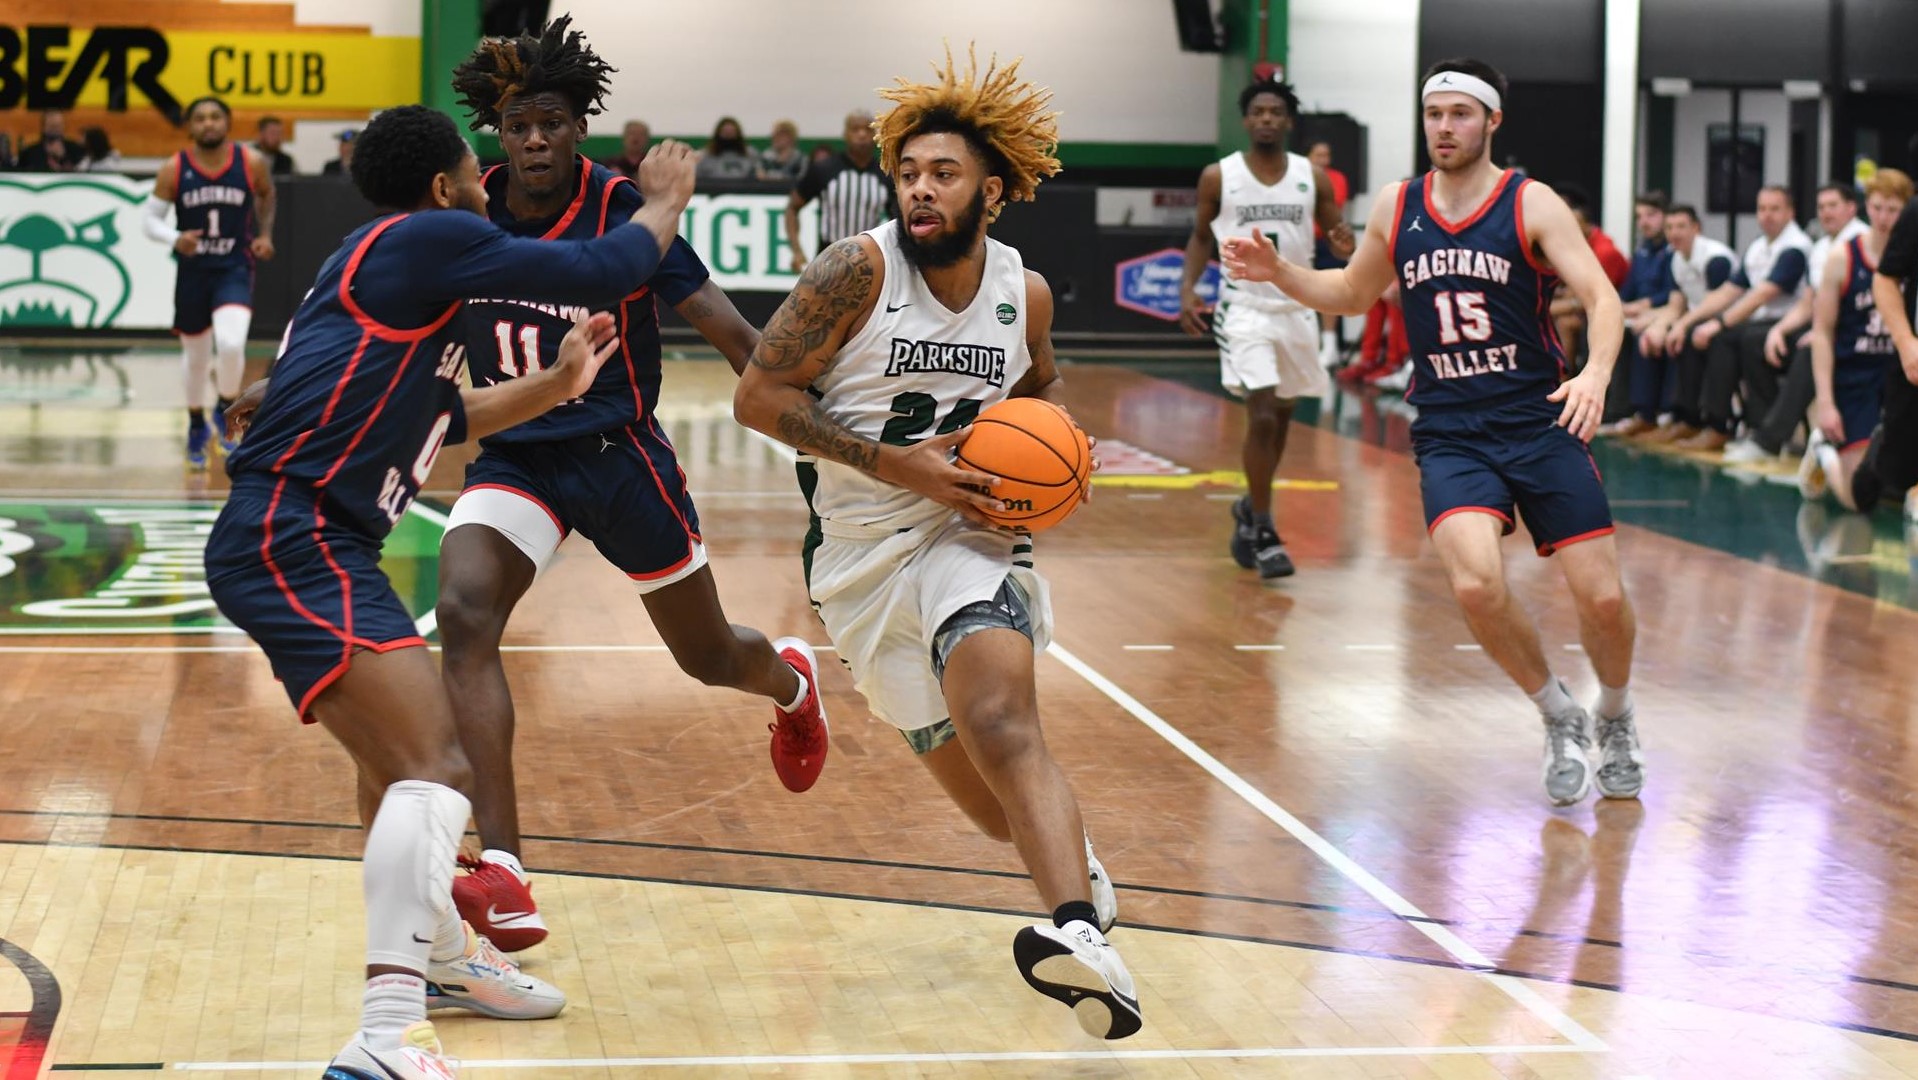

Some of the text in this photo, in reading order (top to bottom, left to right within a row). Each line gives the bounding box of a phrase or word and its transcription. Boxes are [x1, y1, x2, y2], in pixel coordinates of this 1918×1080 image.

[208, 45, 326, 96] CLUB
[207, 208, 220, 238] 1
[1236, 203, 1304, 227] PARKSIDE
[1403, 249, 1512, 290] SAGINAW
[1434, 290, 1493, 345] 15
[494, 319, 545, 380] 11
[884, 337, 1006, 390] PARKSIDE
[1427, 344, 1518, 379] VALLEY
